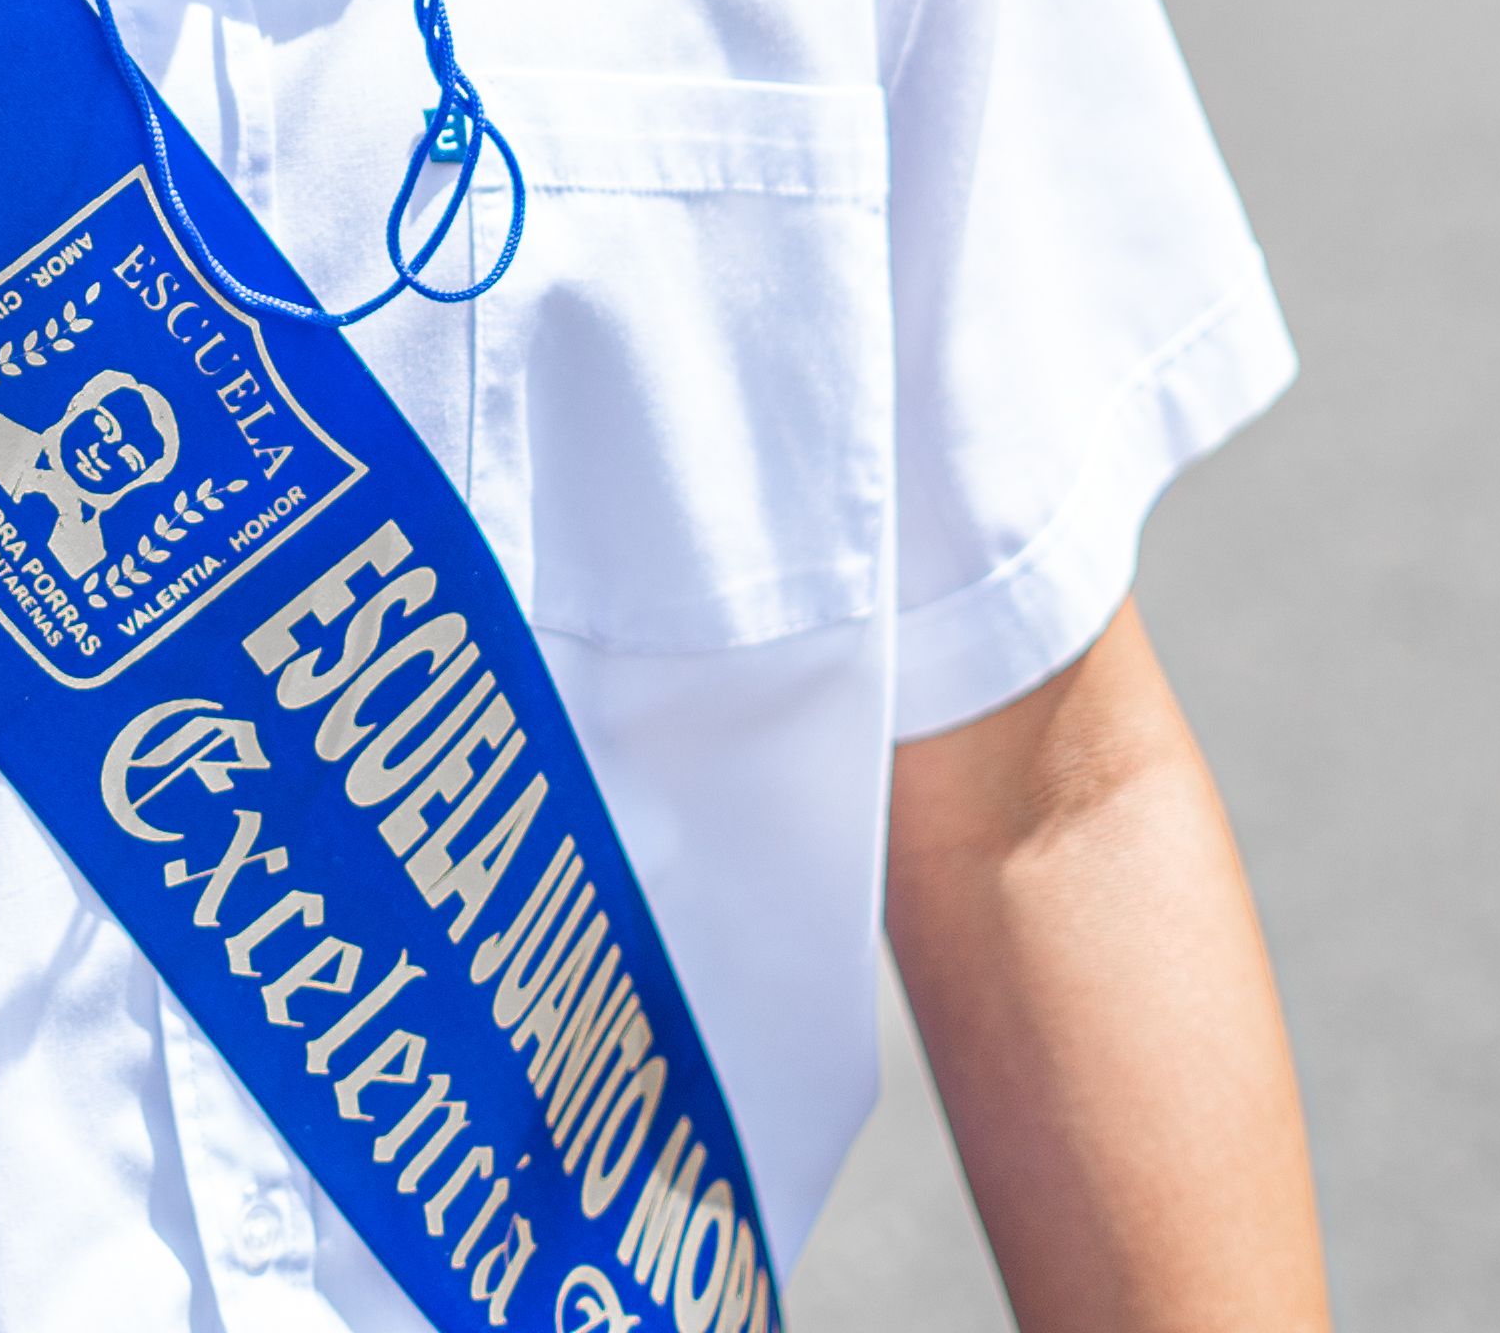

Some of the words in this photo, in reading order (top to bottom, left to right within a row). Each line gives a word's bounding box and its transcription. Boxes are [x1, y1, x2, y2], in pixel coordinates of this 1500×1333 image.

[112, 244, 294, 481] ESCUELA
[20, 557, 102, 657] PORRAS
[228, 485, 307, 553] HONOR
[241, 519, 549, 944] ESCUELA
[470, 834, 668, 1219] JUANITO
[101, 697, 537, 1325] Excelencia
